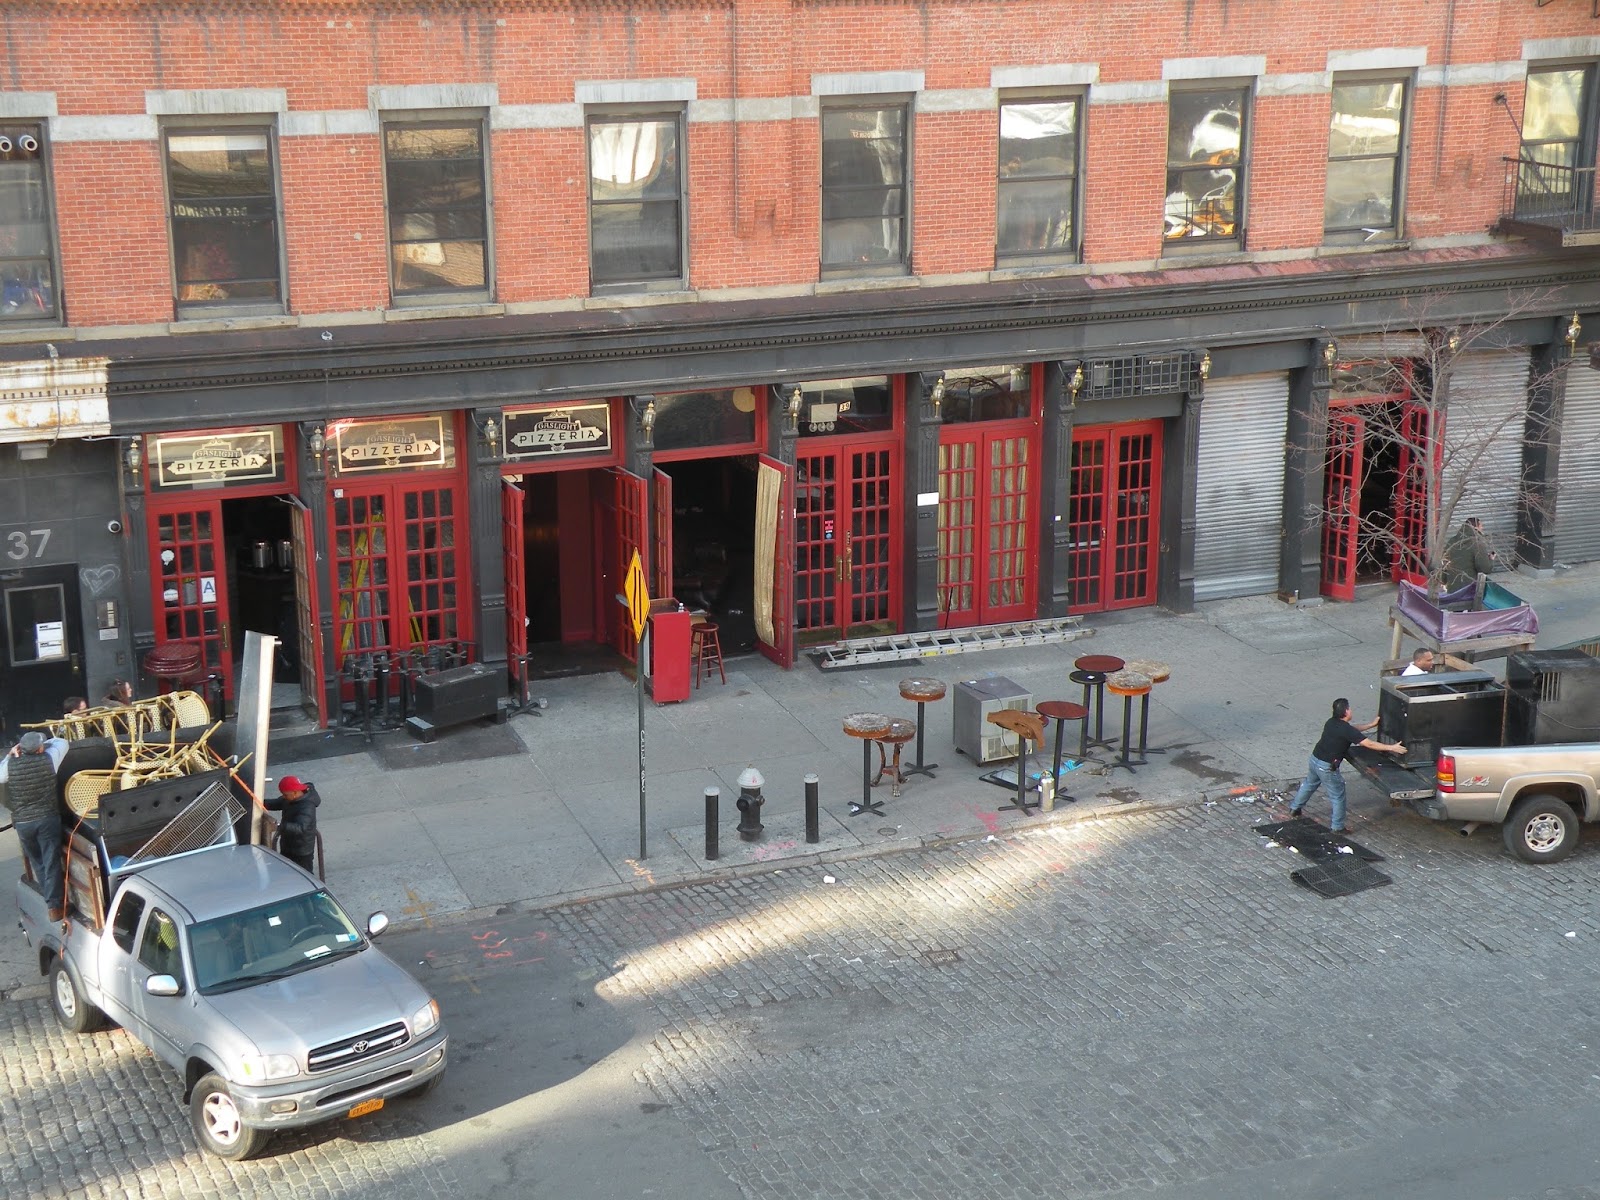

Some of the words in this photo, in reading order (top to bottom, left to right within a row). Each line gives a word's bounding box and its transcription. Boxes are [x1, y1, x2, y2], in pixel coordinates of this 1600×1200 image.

[538, 421, 577, 431] GASLIGHT
[369, 434, 412, 444] GASLIGHT
[519, 430, 596, 444] PIZZERIA
[196, 448, 240, 458] GASLIGHT
[351, 443, 432, 457] PIZZERIA
[176, 457, 259, 471] PIZZERIA
[7, 529, 51, 560] 37
[203, 581, 215, 594] A
